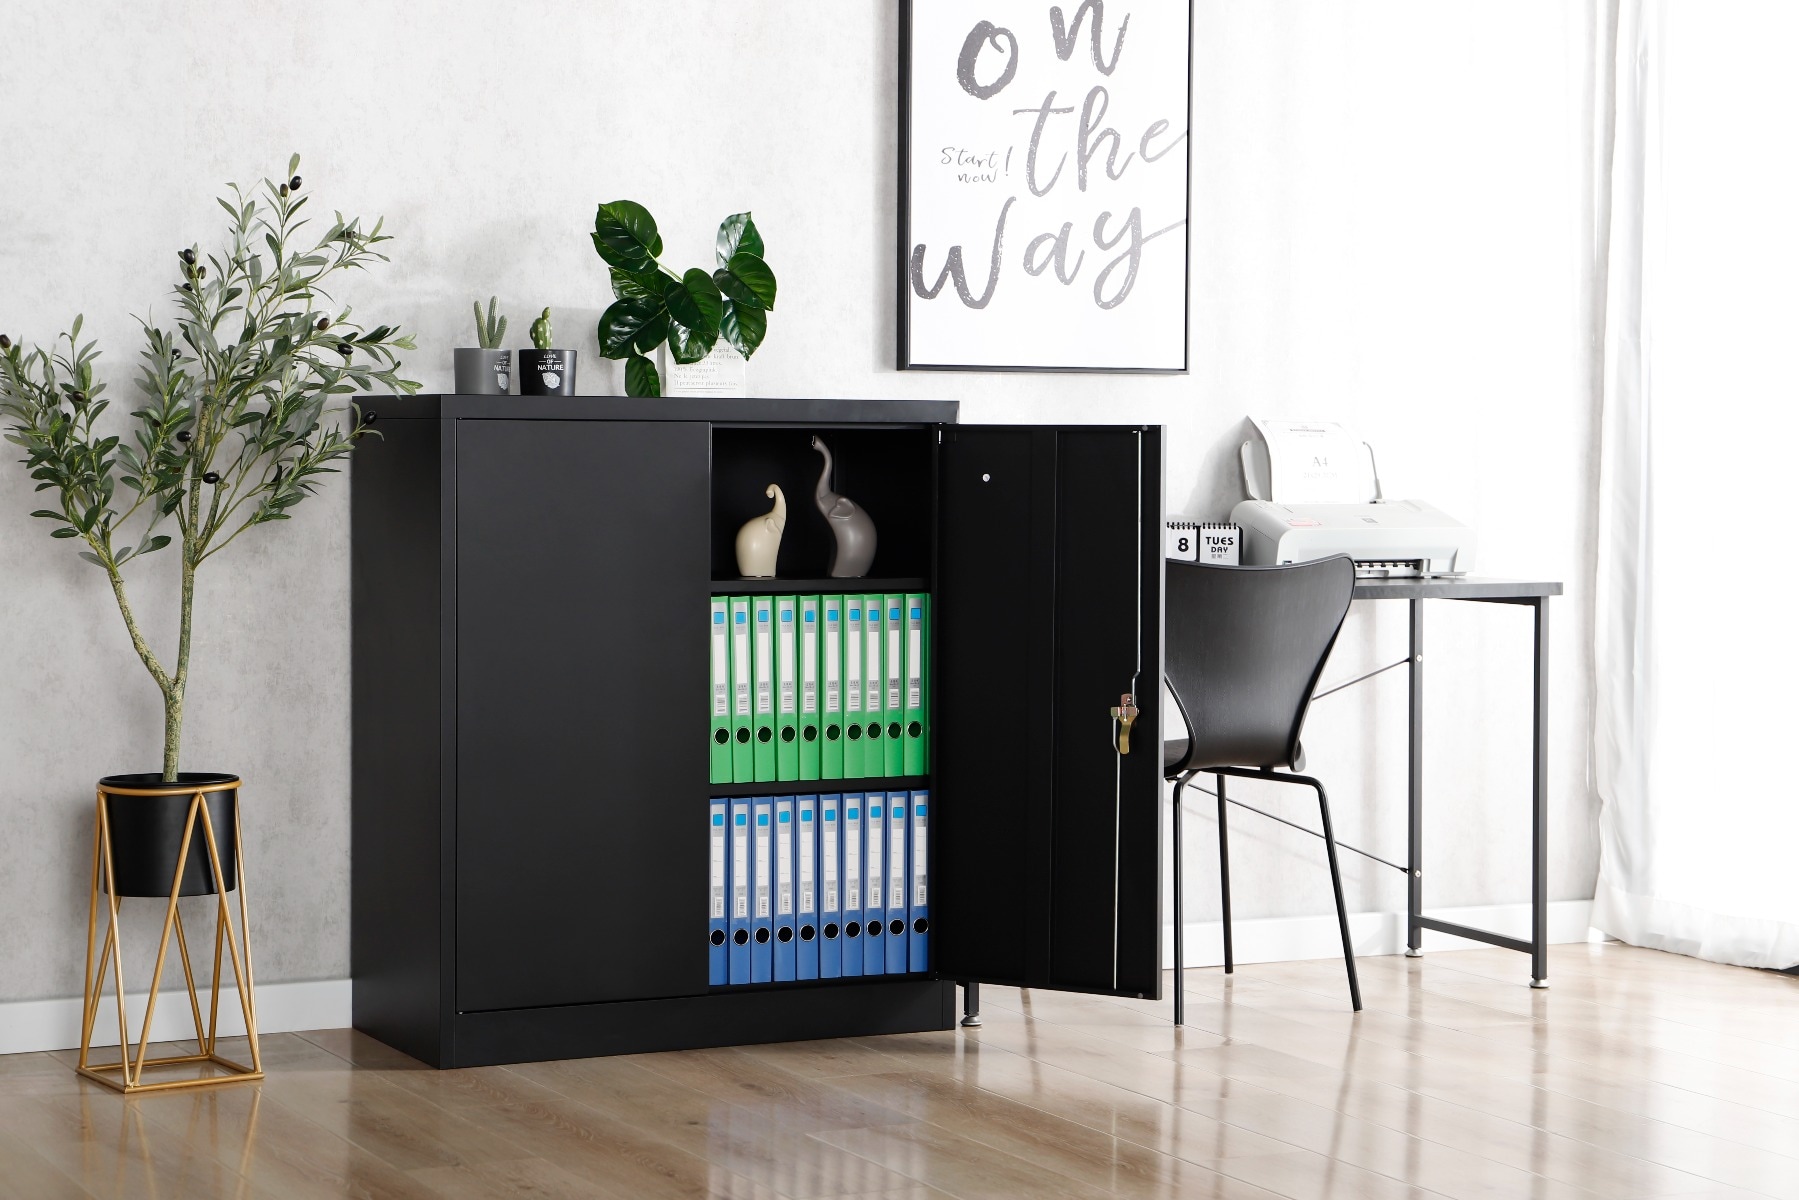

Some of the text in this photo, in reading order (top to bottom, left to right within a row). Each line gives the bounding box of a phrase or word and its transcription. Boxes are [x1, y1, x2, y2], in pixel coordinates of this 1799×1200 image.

[957, 0, 1131, 100] on
[1013, 86, 1188, 198] the
[1312, 456, 1329, 467] A4
[1177, 537, 1189, 552] 8
[1205, 536, 1234, 546] TUES
